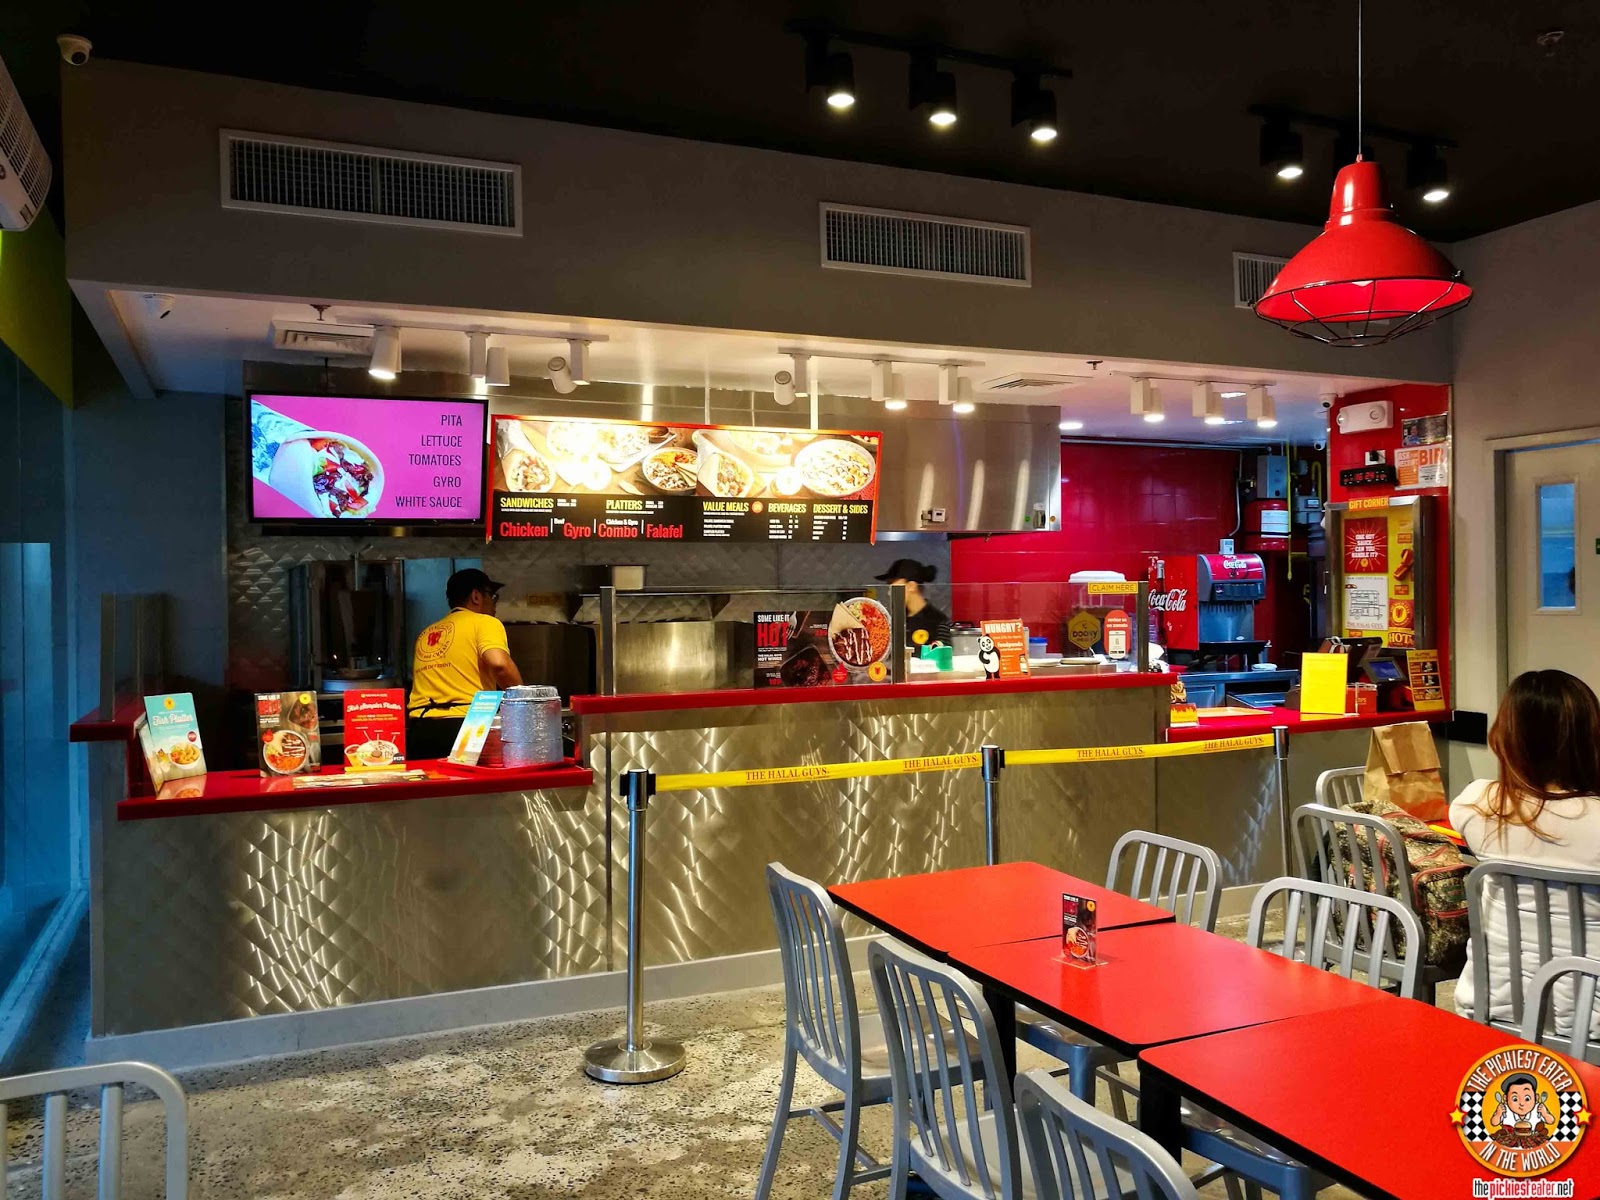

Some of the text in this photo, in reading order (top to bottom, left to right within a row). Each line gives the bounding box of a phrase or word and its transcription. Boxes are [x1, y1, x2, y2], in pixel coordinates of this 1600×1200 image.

[441, 415, 462, 426] PITA
[421, 435, 462, 447] LETTUCE
[409, 454, 461, 466] TOMATOES
[433, 476, 461, 488] GYRO
[395, 496, 462, 508] WHITE SAUCE
[500, 497, 554, 509] SANDWICHES
[606, 500, 643, 511] PLATTERS
[703, 501, 725, 511] VALUE
[726, 502, 749, 512] MEALS
[768, 503, 806, 513] BEVERAGES
[1348, 498, 1388, 509] GIFT CORNER
[813, 504, 868, 514] DESSERT & SIDES
[500, 522, 548, 537] Chicken
[563, 523, 591, 540] Gyro
[598, 524, 638, 538] Combo
[646, 524, 683, 538] Falafel
[757, 614, 790, 622] SOME LIKE IT
[984, 622, 1021, 634] HUNGRY?
[757, 622, 790, 647] HOT
[1203, 741, 1218, 749] THE
[1219, 739, 1244, 748] HALAL
[1077, 749, 1094, 758] THE
[1095, 748, 1120, 757] HALAL
[903, 760, 921, 769] THE
[923, 757, 953, 767] HALAL
[746, 770, 766, 780] THE
[768, 768, 800, 779] HALAL
